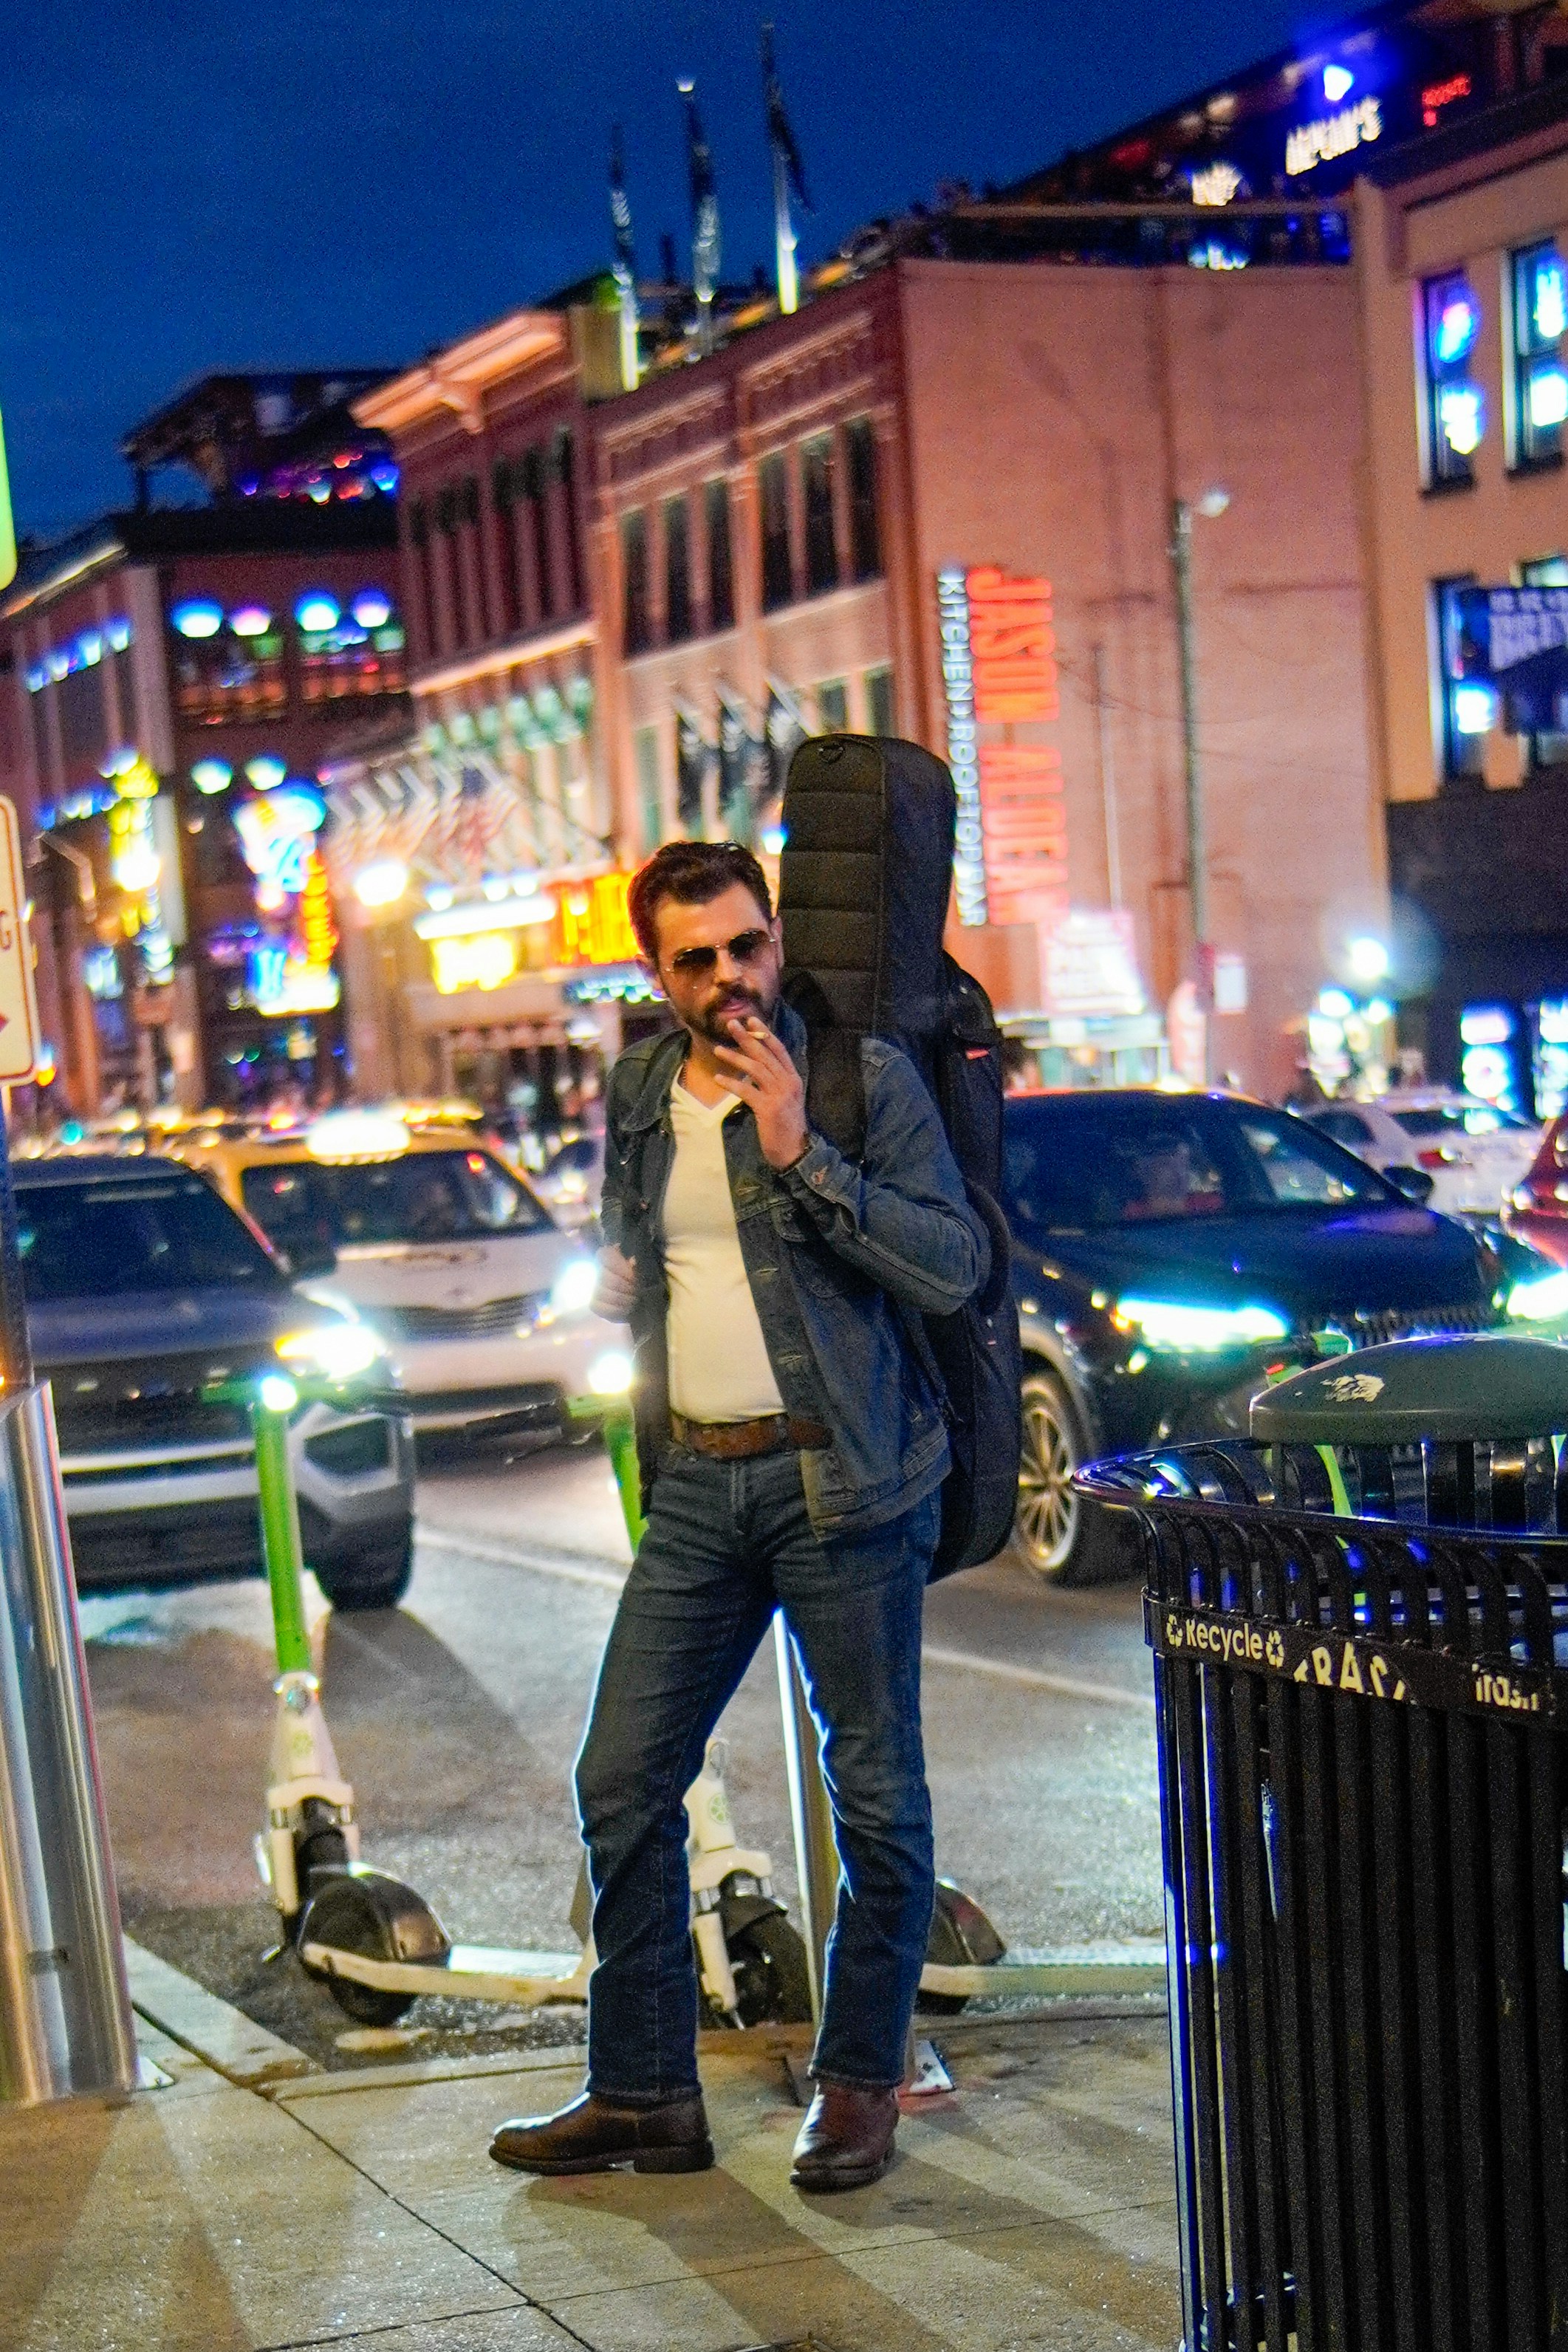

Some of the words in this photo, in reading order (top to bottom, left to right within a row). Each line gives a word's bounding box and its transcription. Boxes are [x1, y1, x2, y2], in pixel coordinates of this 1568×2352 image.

[937, 567, 973, 702] KITCHEN
[966, 567, 1061, 724] JASON
[947, 719, 983, 861] ROOFTOP
[977, 744, 1070, 926] ALDEAN
[954, 861, 987, 926] BAR
[1185, 1618, 1264, 1662] Recycle
